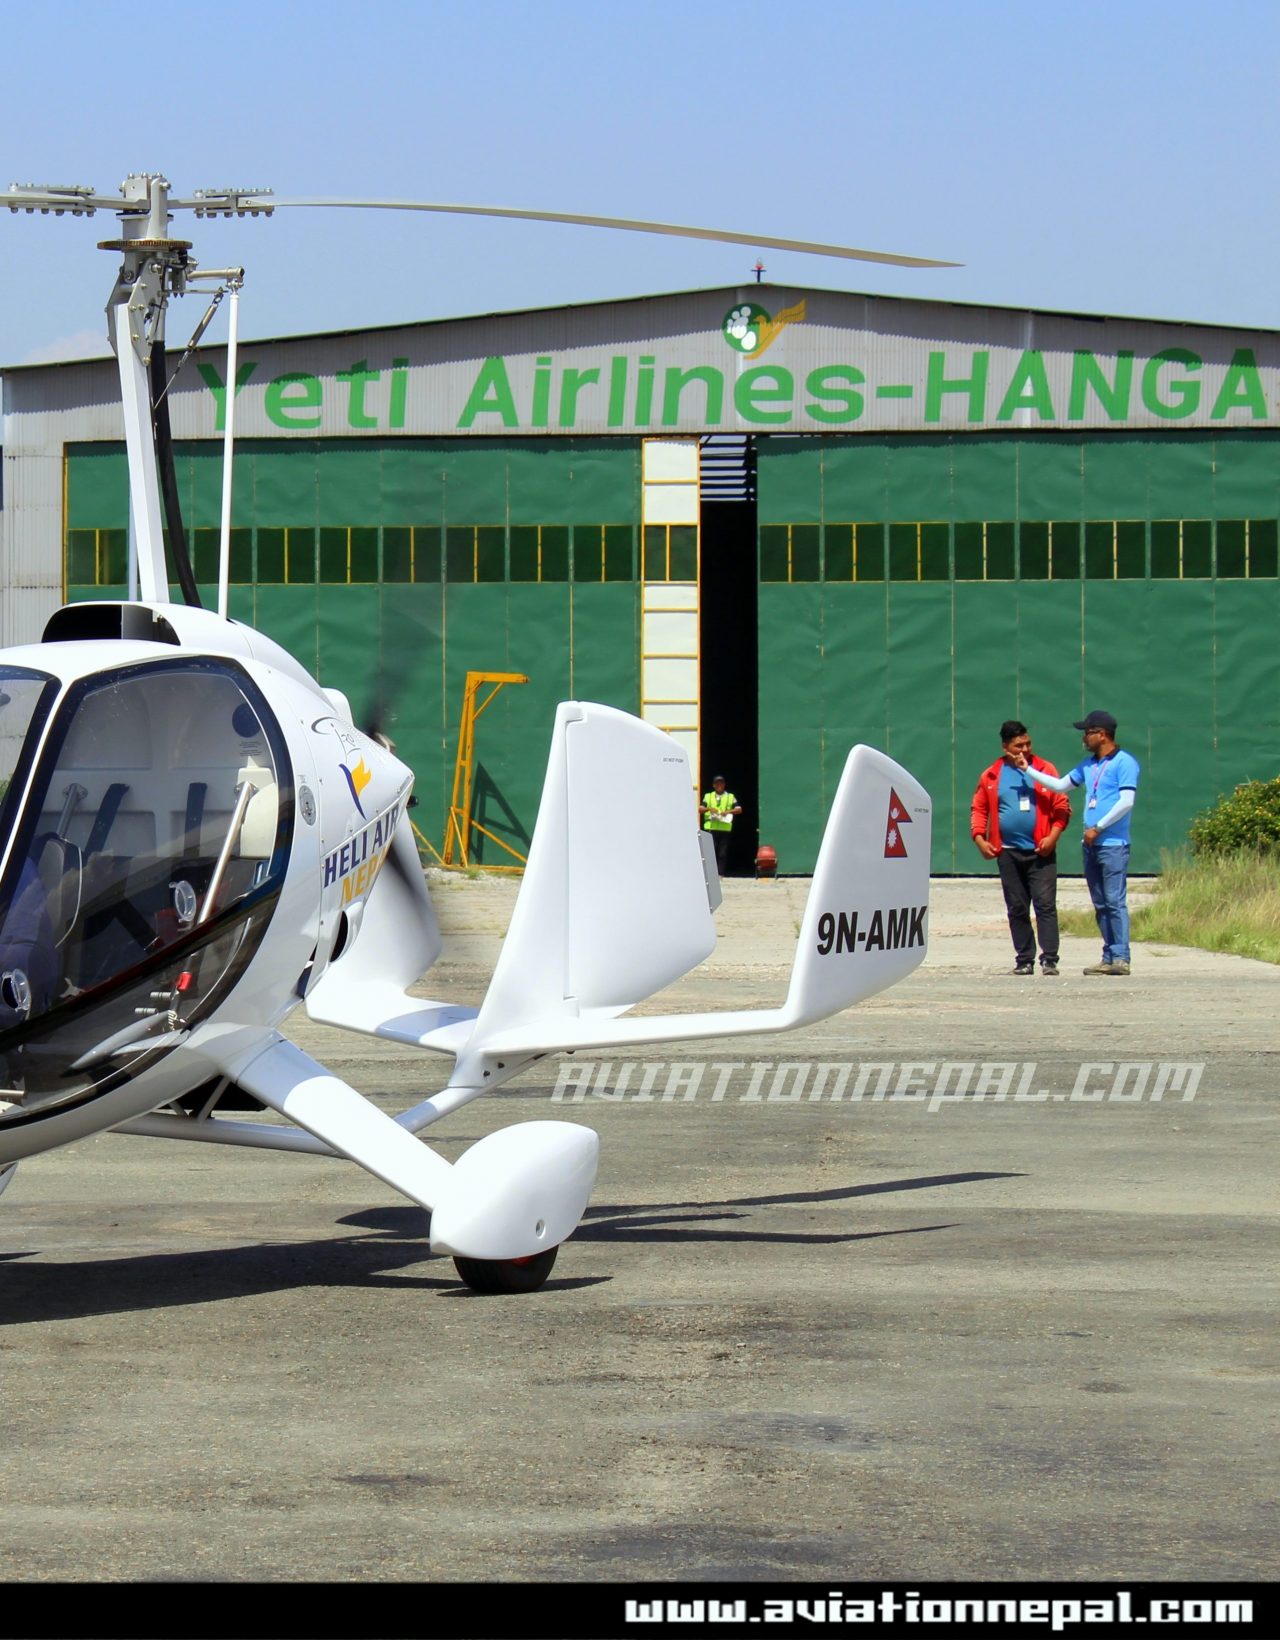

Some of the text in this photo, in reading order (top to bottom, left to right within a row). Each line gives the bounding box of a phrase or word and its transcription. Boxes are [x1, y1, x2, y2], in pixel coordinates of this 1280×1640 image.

[197, 347, 1269, 431] Yeti Airlines-HANGA
[324, 804, 400, 888] HELI AIR
[340, 846, 387, 907] NEP
[817, 905, 927, 956] 9N-AMK
